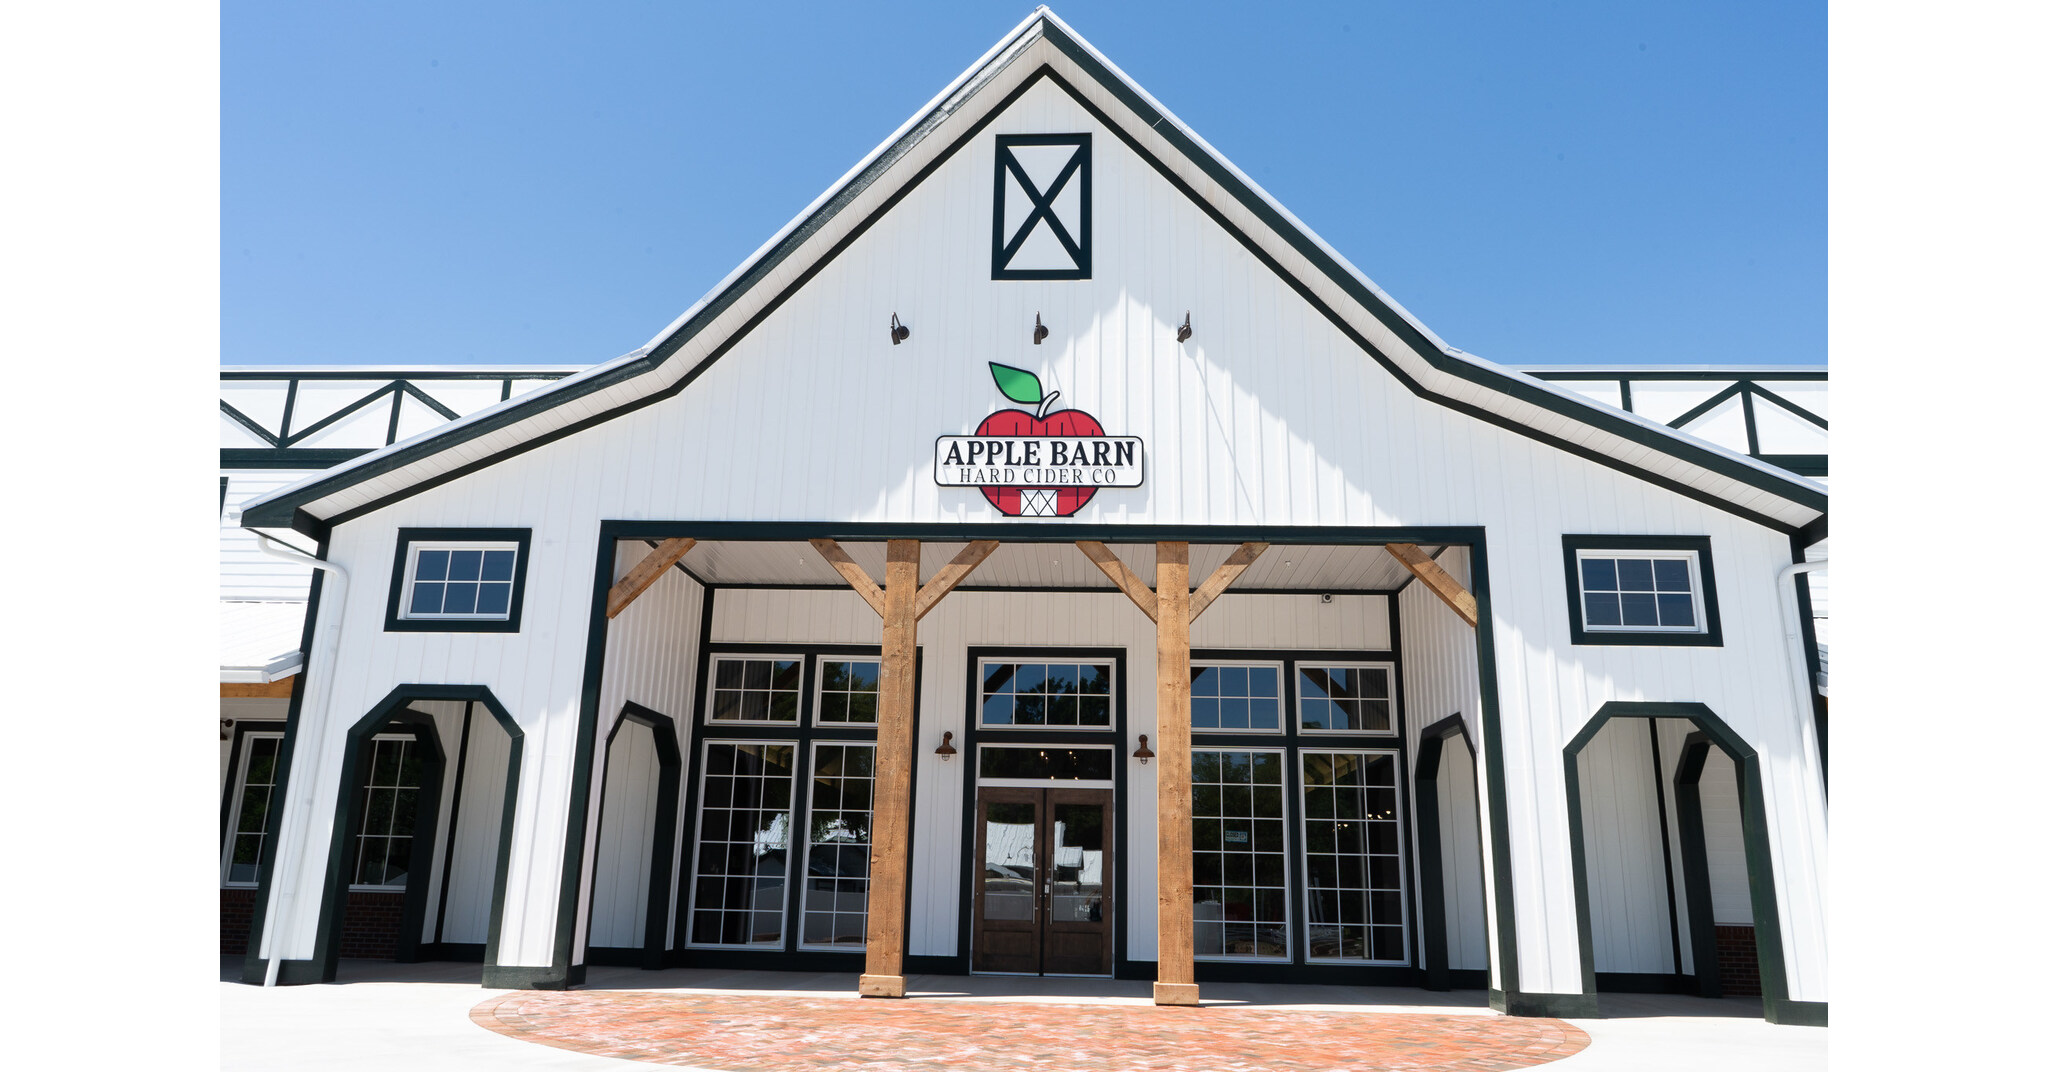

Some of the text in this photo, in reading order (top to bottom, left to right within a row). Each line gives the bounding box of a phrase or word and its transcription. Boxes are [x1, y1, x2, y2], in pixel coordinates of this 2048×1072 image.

[943, 440, 1135, 467] APPLE BARN
[960, 468, 1116, 484] HARD CIDER CO
